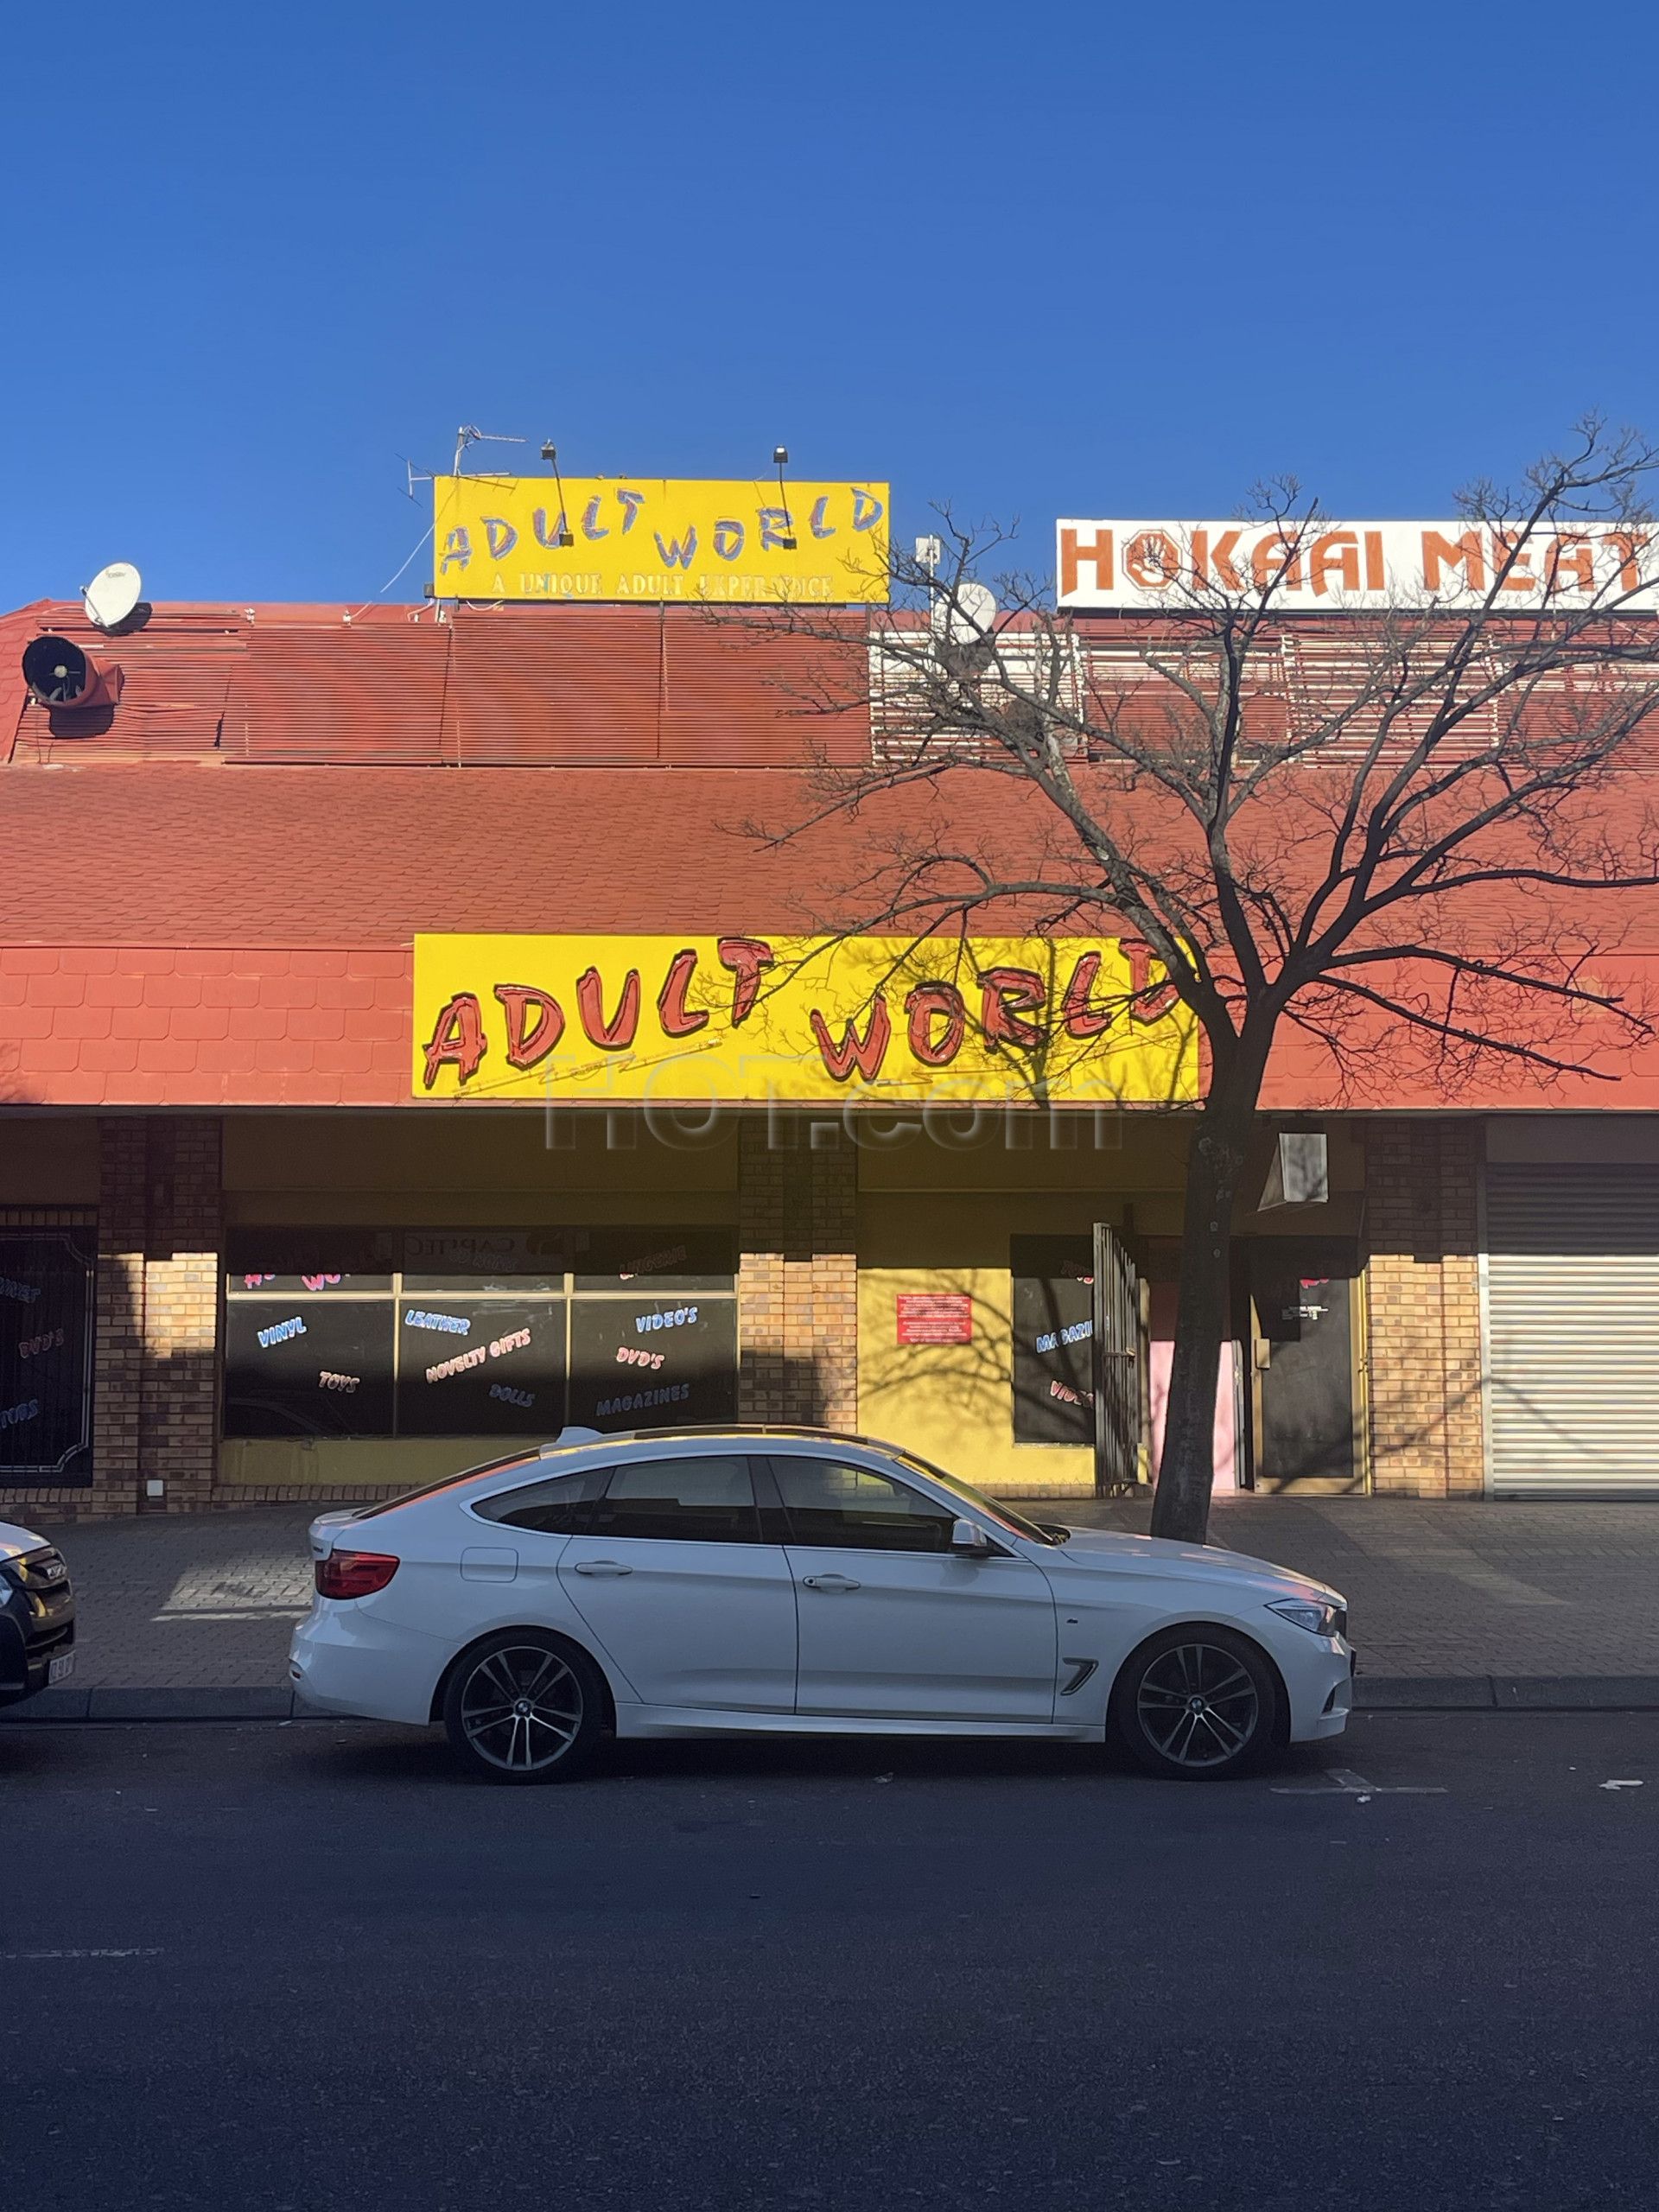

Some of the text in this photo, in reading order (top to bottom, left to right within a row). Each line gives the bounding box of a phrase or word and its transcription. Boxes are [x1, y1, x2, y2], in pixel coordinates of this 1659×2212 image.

[439, 486, 883, 575] ADULT WORLD
[1421, 530, 1649, 592] MEAT
[493, 573, 505, 594] A
[520, 573, 602, 594] UNIQUE
[616, 574, 683, 596] ADULT
[422, 938, 1180, 1089] ADULT WORLD
[257, 1316, 308, 1349] VINYL
[404, 1309, 472, 1336] LEATHER
[635, 1306, 698, 1333] VIDEO'S
[426, 1327, 531, 1384] NOVELTY GIFTS
[615, 1346, 665, 1370] DVD'S
[319, 1370, 360, 1393] TOYS
[595, 1383, 690, 1416] MAGAZINES
